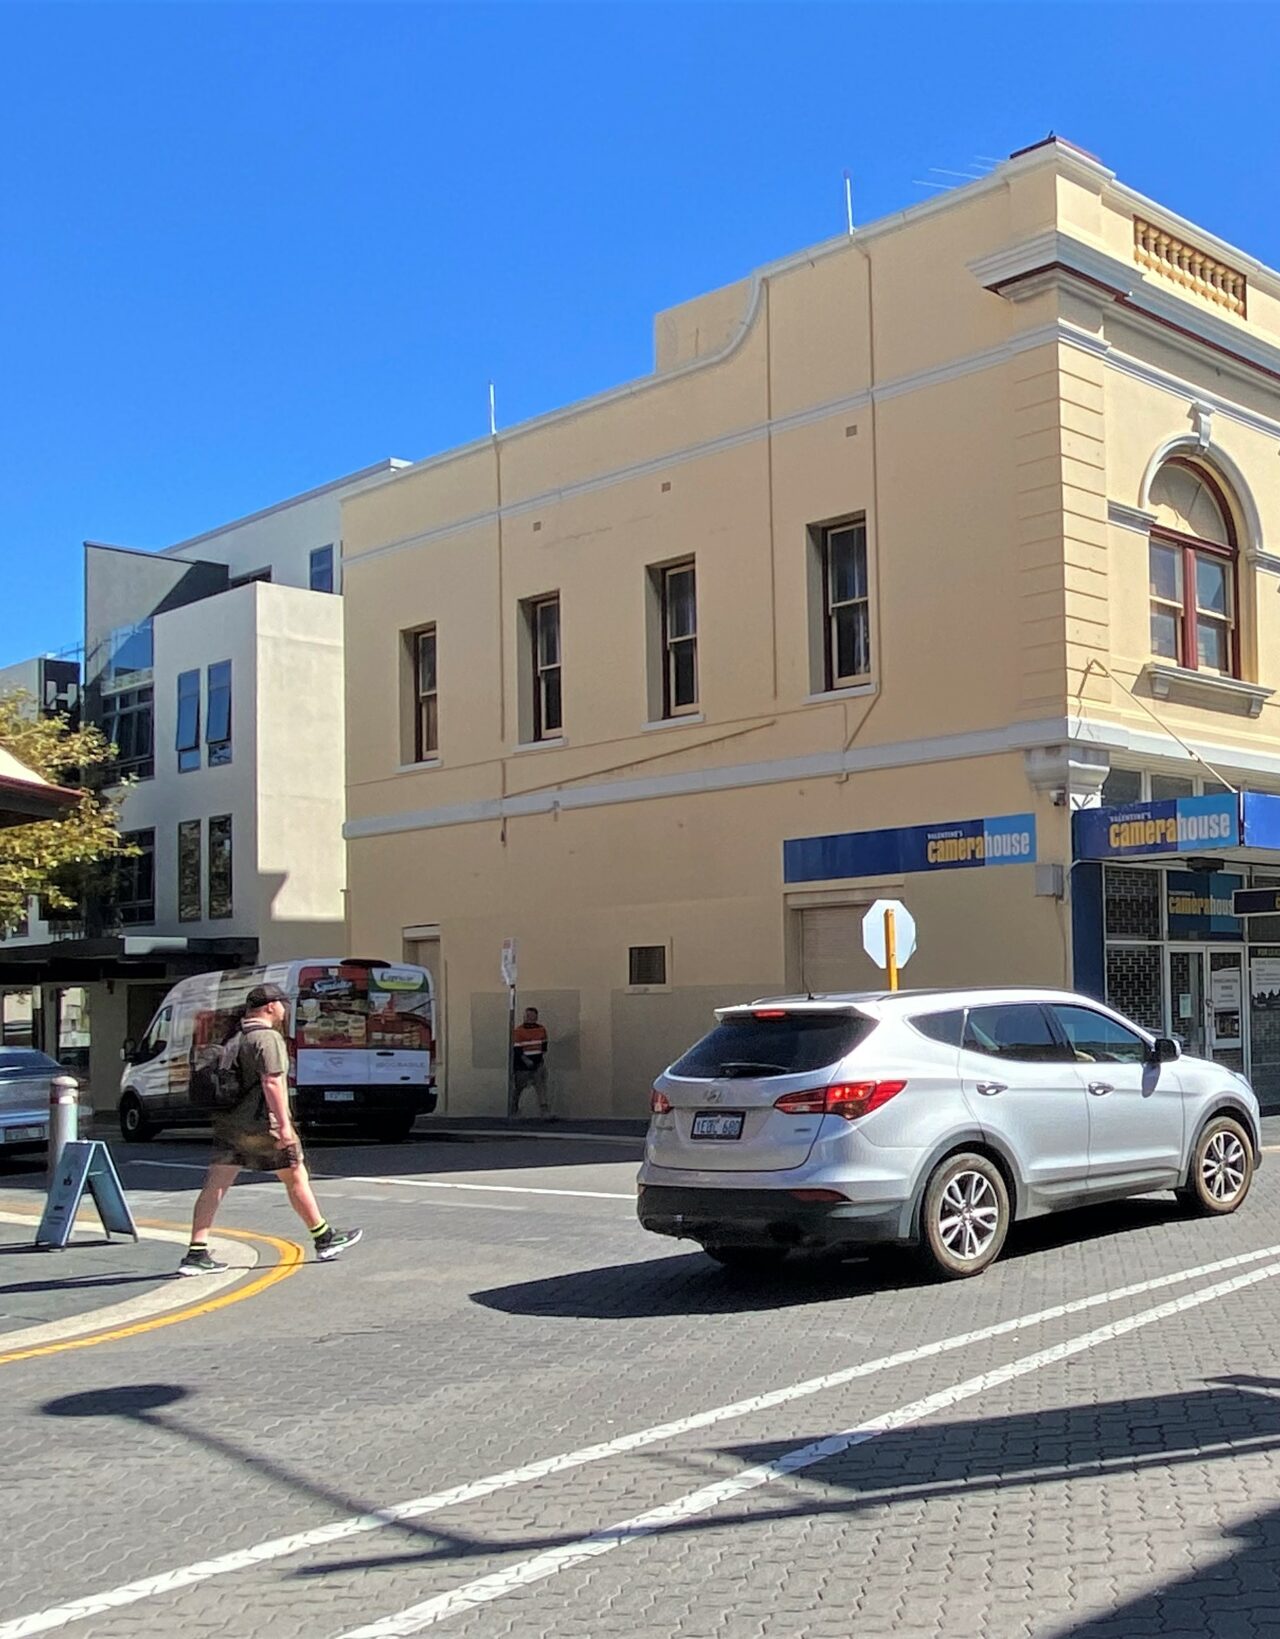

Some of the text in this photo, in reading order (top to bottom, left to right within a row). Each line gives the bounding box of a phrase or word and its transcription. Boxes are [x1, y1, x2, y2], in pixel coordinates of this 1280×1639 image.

[927, 830, 1030, 864] camerahouse
[1109, 811, 1231, 849] camerahouse
[1168, 894, 1234, 915] camerahous
